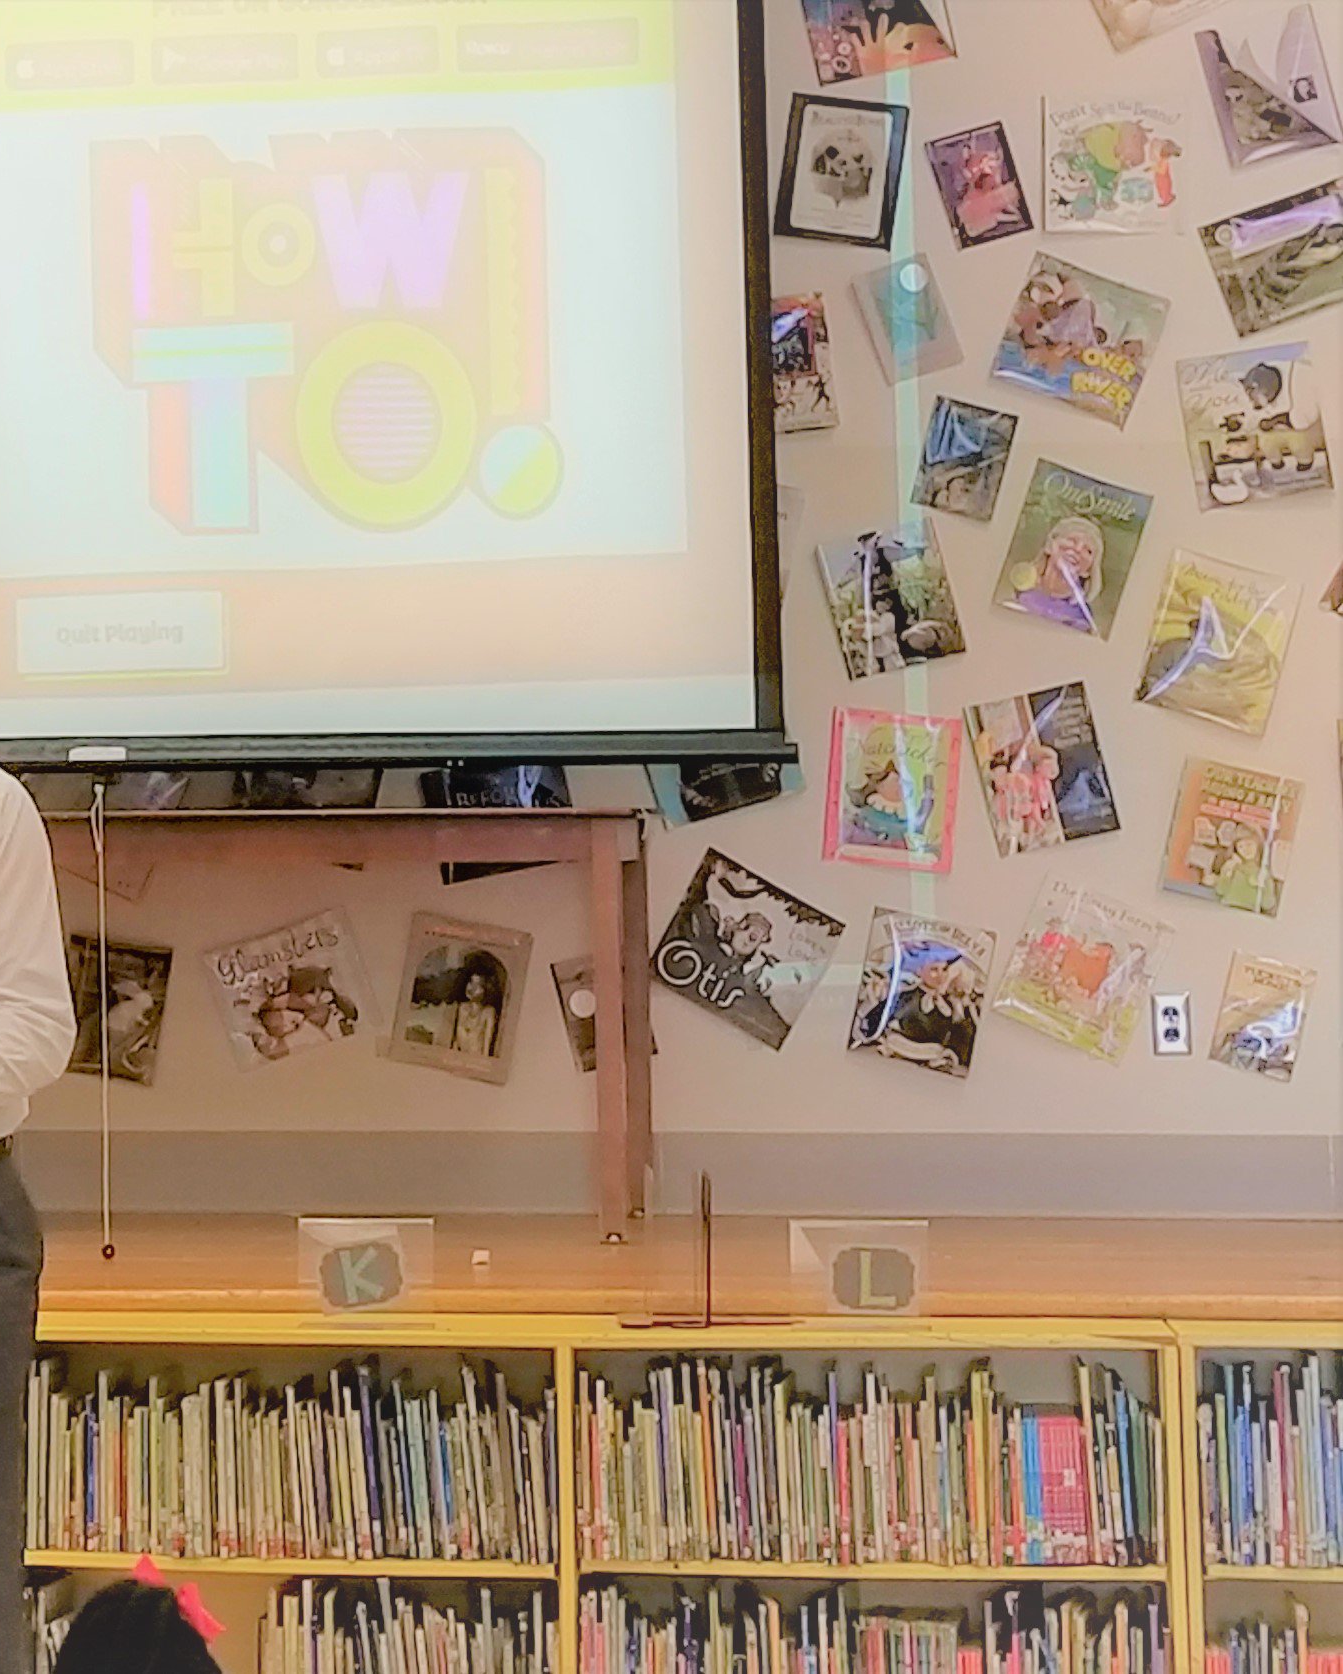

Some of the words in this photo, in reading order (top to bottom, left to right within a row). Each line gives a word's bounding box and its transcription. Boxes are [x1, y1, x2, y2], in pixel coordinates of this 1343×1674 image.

[1081, 347, 1137, 382] OVER
[1043, 471, 1081, 501] One
[1077, 486, 1137, 520] Smile
[57, 622, 100, 647] Quit
[105, 620, 184, 645] Playing
[657, 940, 746, 1008] Otis
[339, 1245, 385, 1302] K
[858, 1250, 897, 1306] L
